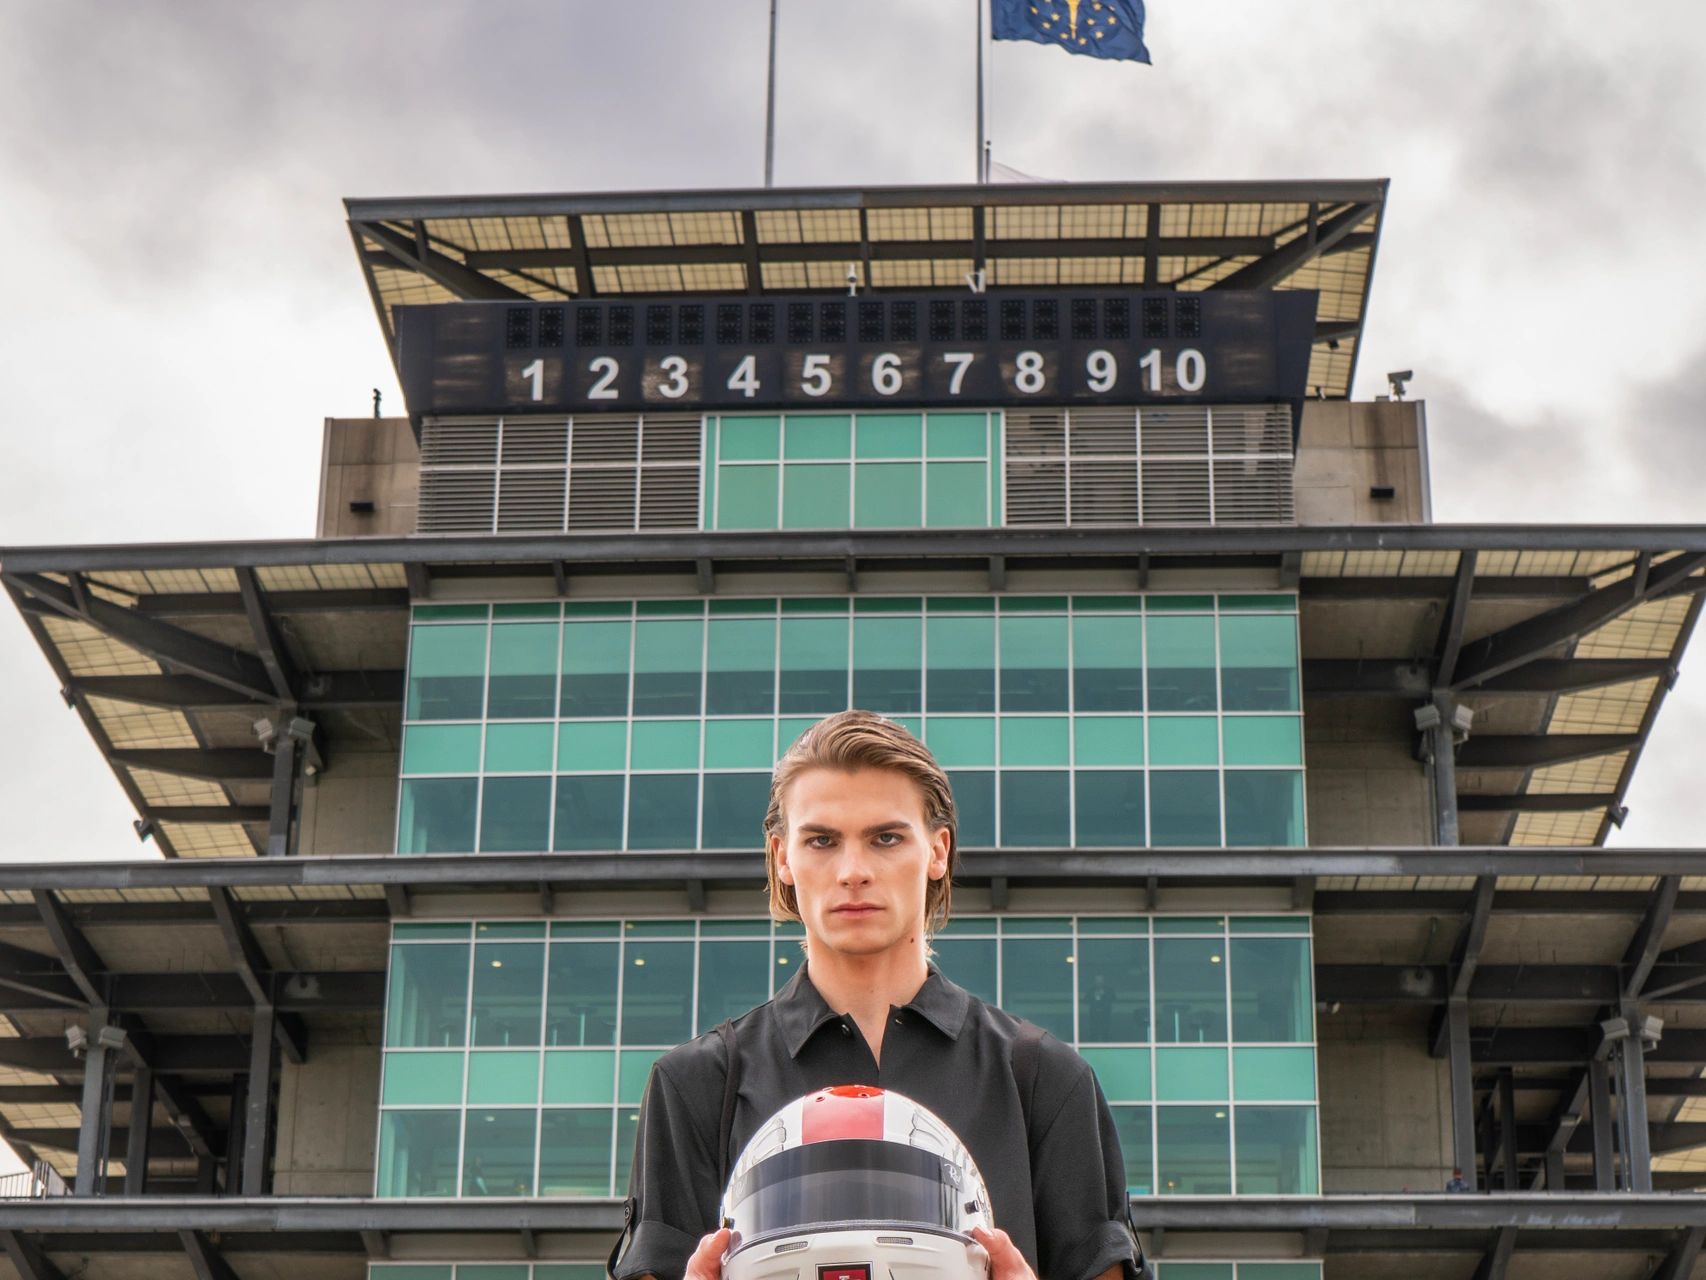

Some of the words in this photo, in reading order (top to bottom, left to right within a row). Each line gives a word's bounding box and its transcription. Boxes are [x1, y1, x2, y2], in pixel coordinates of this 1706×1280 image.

[522, 358, 544, 401] 1
[587, 356, 620, 400] 2
[658, 355, 689, 398] 3
[727, 355, 761, 397] 4
[801, 354, 833, 396] 5
[871, 352, 903, 395] 6
[943, 352, 975, 395] 7
[1014, 350, 1046, 393] 8
[1086, 349, 1118, 392] 9
[1139, 348, 1207, 393] 10
